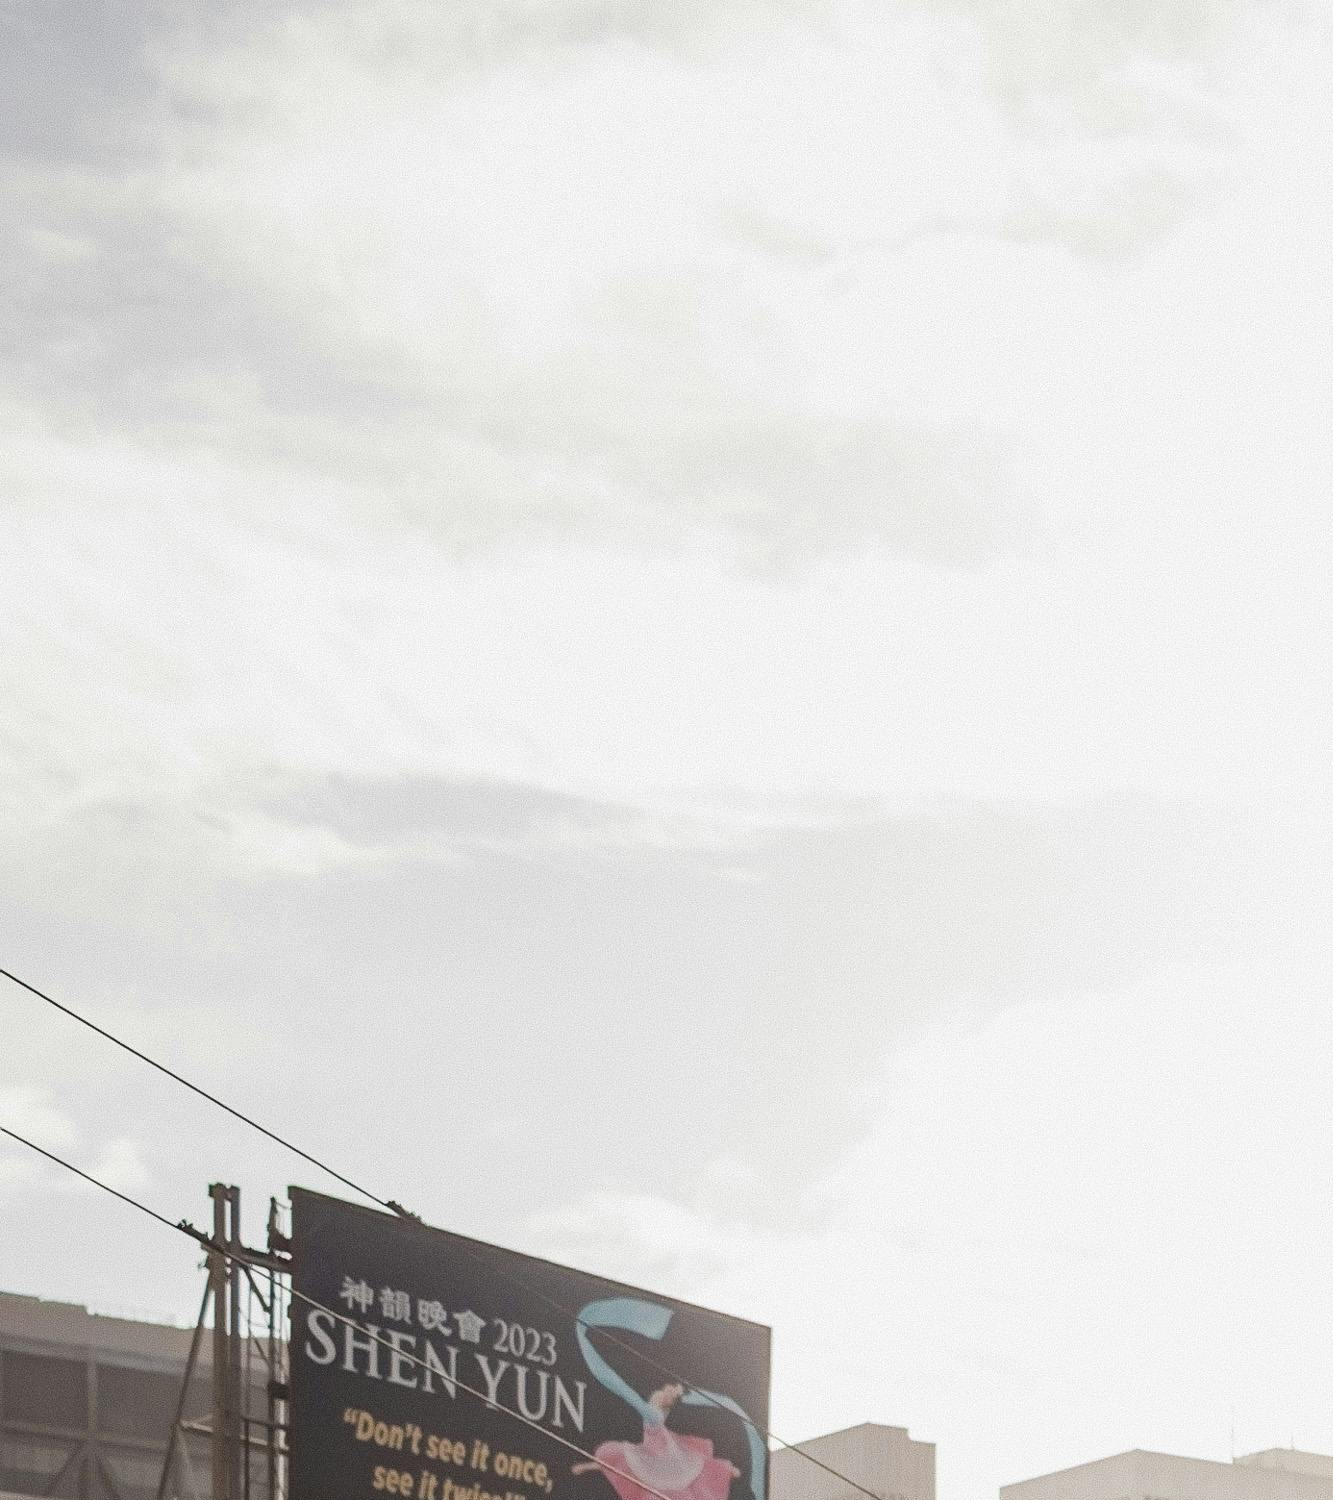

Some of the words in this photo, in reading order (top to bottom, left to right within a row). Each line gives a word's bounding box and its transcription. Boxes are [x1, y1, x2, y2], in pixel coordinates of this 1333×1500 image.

[493, 1317, 558, 1367] 2023
[305, 1309, 458, 1400] SHEN
[474, 1353, 588, 1433] YUN
[373, 1465, 414, 1497] see
[426, 1429, 466, 1464] see
[471, 1436, 488, 1472] it
[493, 1453, 554, 1493] once,
